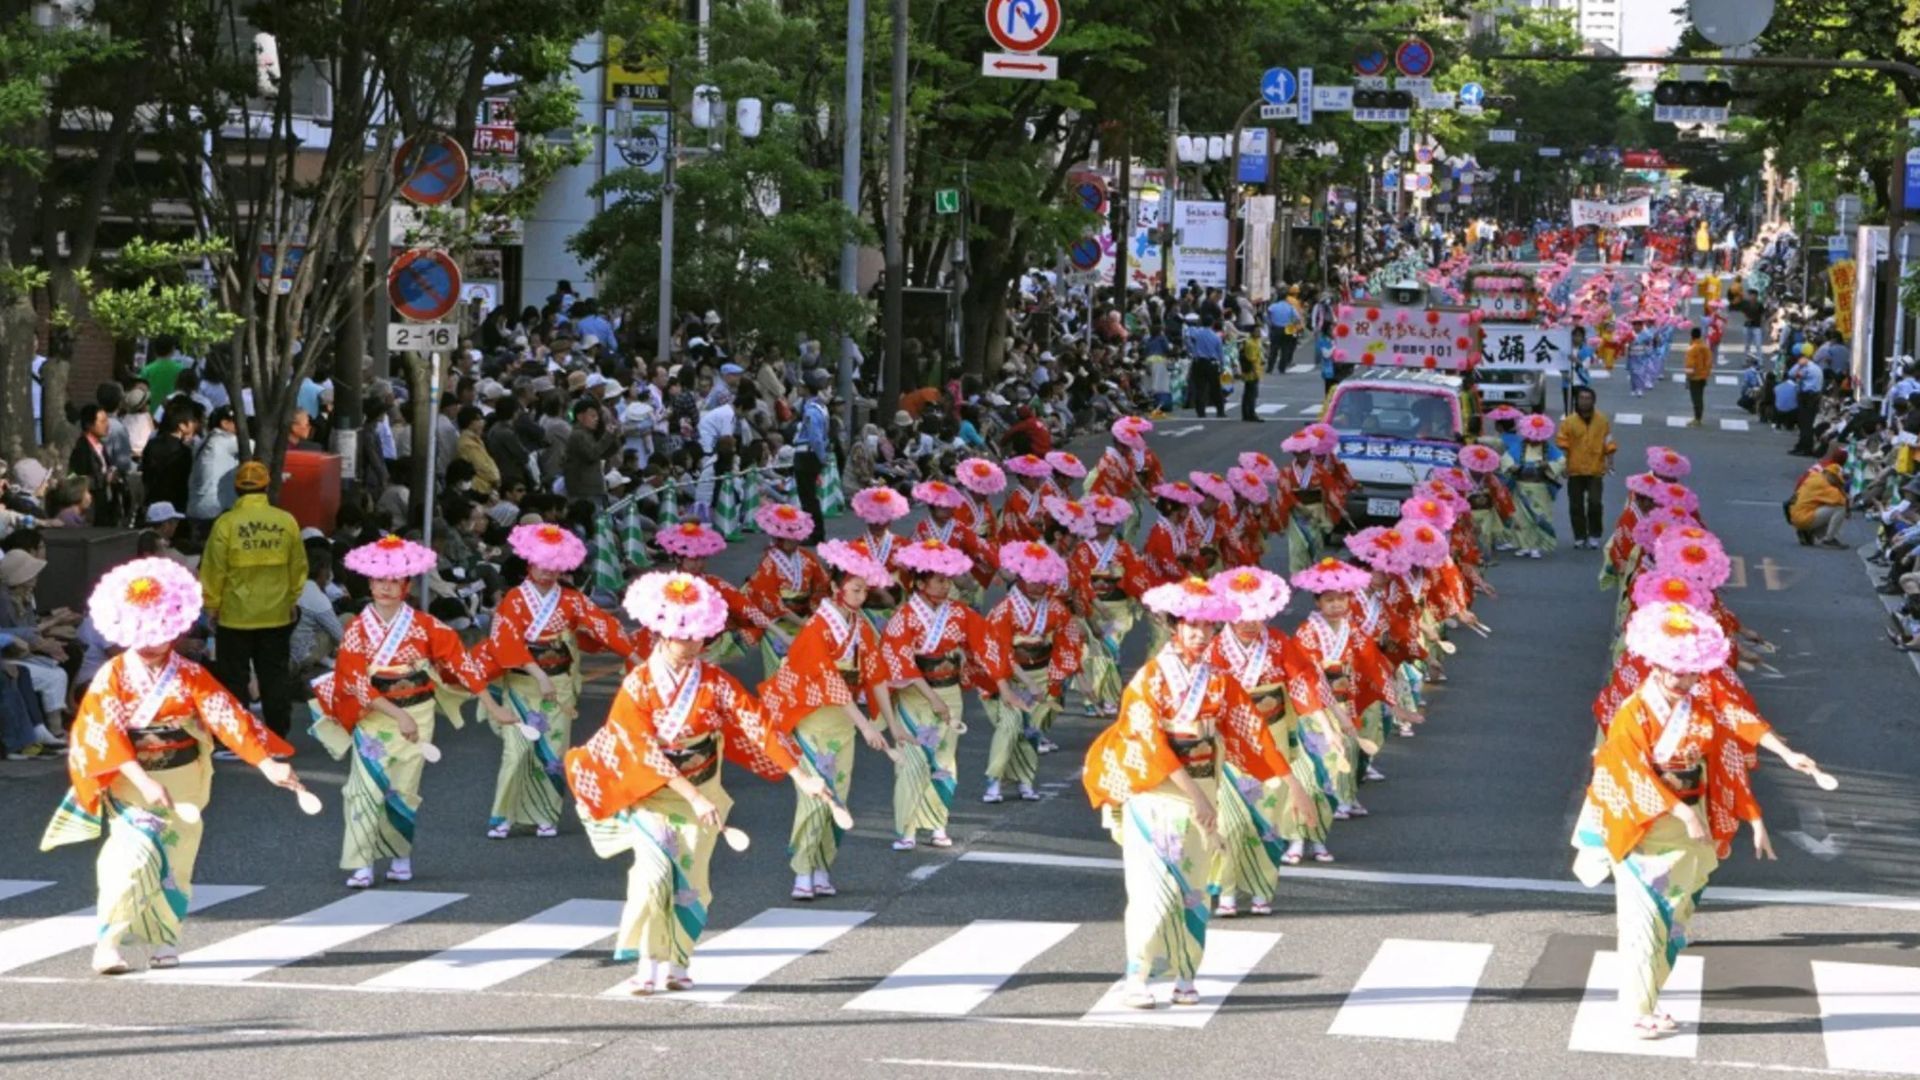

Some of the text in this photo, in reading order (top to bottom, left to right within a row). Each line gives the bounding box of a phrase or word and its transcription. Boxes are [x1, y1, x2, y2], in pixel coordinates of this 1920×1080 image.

[397, 328, 449, 345] 2-16
[1430, 344, 1452, 357] 101
[242, 539, 281, 550] STAFF
